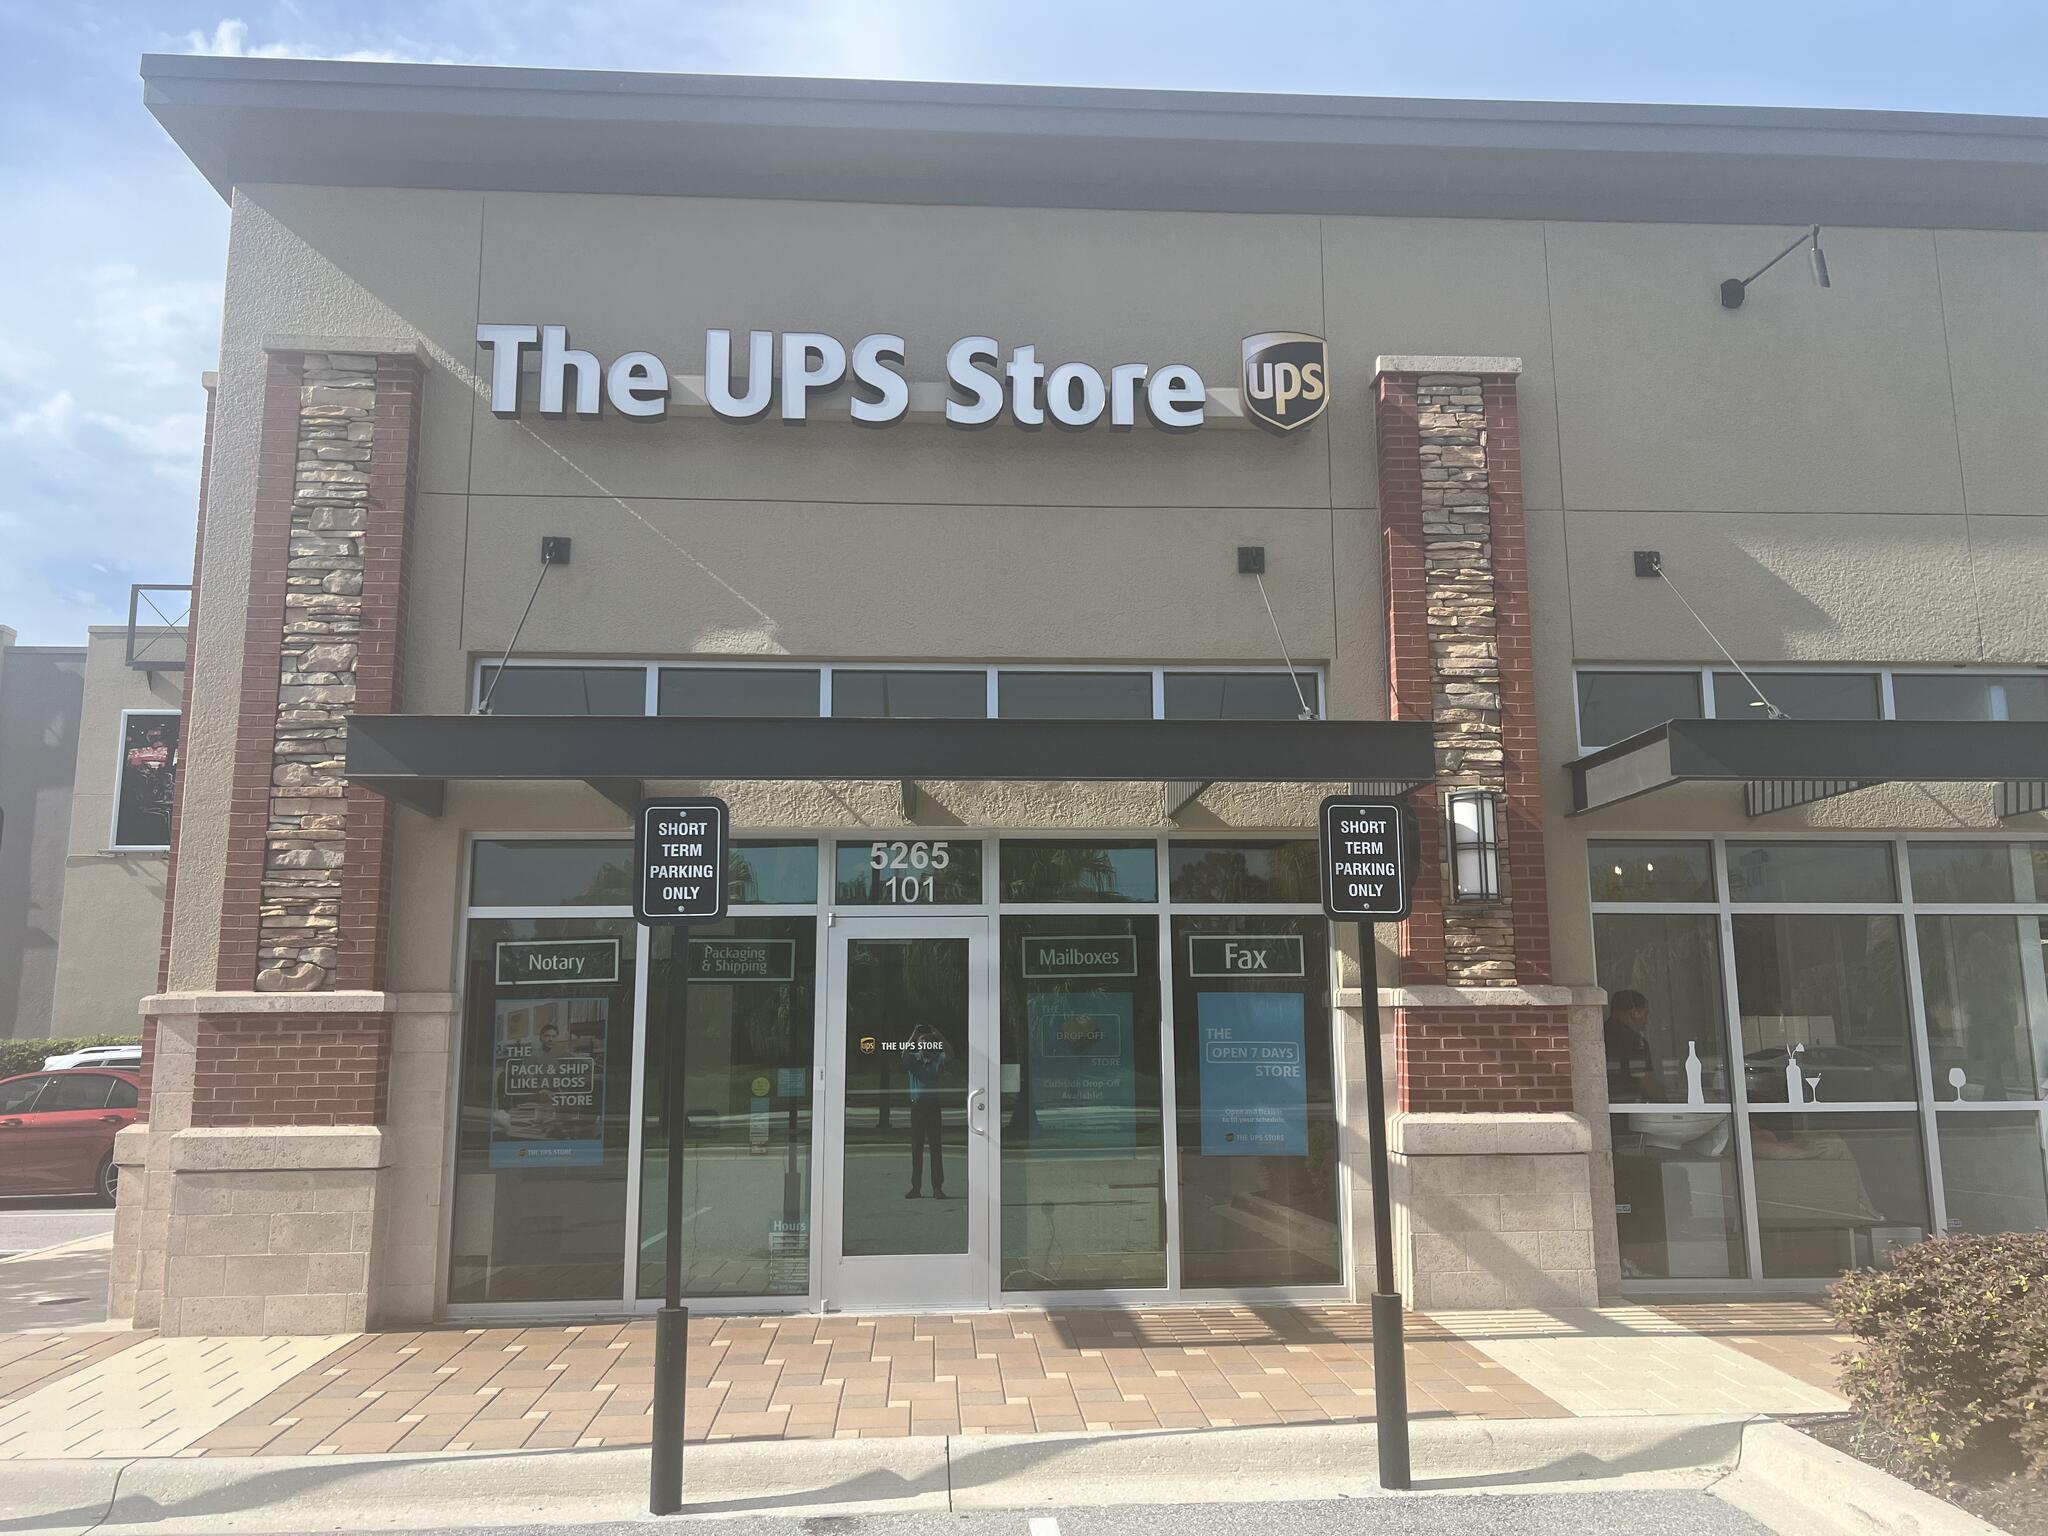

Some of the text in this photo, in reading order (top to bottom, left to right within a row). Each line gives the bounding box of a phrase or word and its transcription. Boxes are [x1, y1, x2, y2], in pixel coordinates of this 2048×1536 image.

[477, 323, 1207, 428] The UPS Store
[1248, 362, 1324, 416] ups
[658, 822, 708, 836] SHORT
[1340, 820, 1387, 834] SHORT
[661, 843, 703, 857] TERM
[1344, 841, 1383, 855] TERM
[870, 841, 950, 870] 5265
[649, 864, 714, 879] PARKING
[1335, 862, 1395, 876] PARKING
[662, 886, 700, 900] ONLY
[885, 876, 934, 903] 101
[1348, 883, 1383, 897] ONLY
[704, 945, 766, 962] Packaging
[1039, 948, 1120, 966] Mailboxes
[1224, 942, 1268, 970] Fax
[528, 953, 586, 974] Notary
[702, 959, 768, 975] & Shipping
[1056, 1031, 1106, 1041] DROP-OFF
[1205, 1027, 1233, 1040] THE
[506, 1046, 533, 1057] THE
[881, 1041, 944, 1051] THE UPS STORE
[1211, 1047, 1294, 1060] OPEN 7 DAYS
[511, 1063, 589, 1075] PACK & SHIP
[1090, 1057, 1121, 1067] STORE
[1255, 1065, 1301, 1078] STORE
[511, 1077, 585, 1089] LIKE A BOSS
[552, 1095, 593, 1106] STORE
[773, 1219, 807, 1232] Hours
